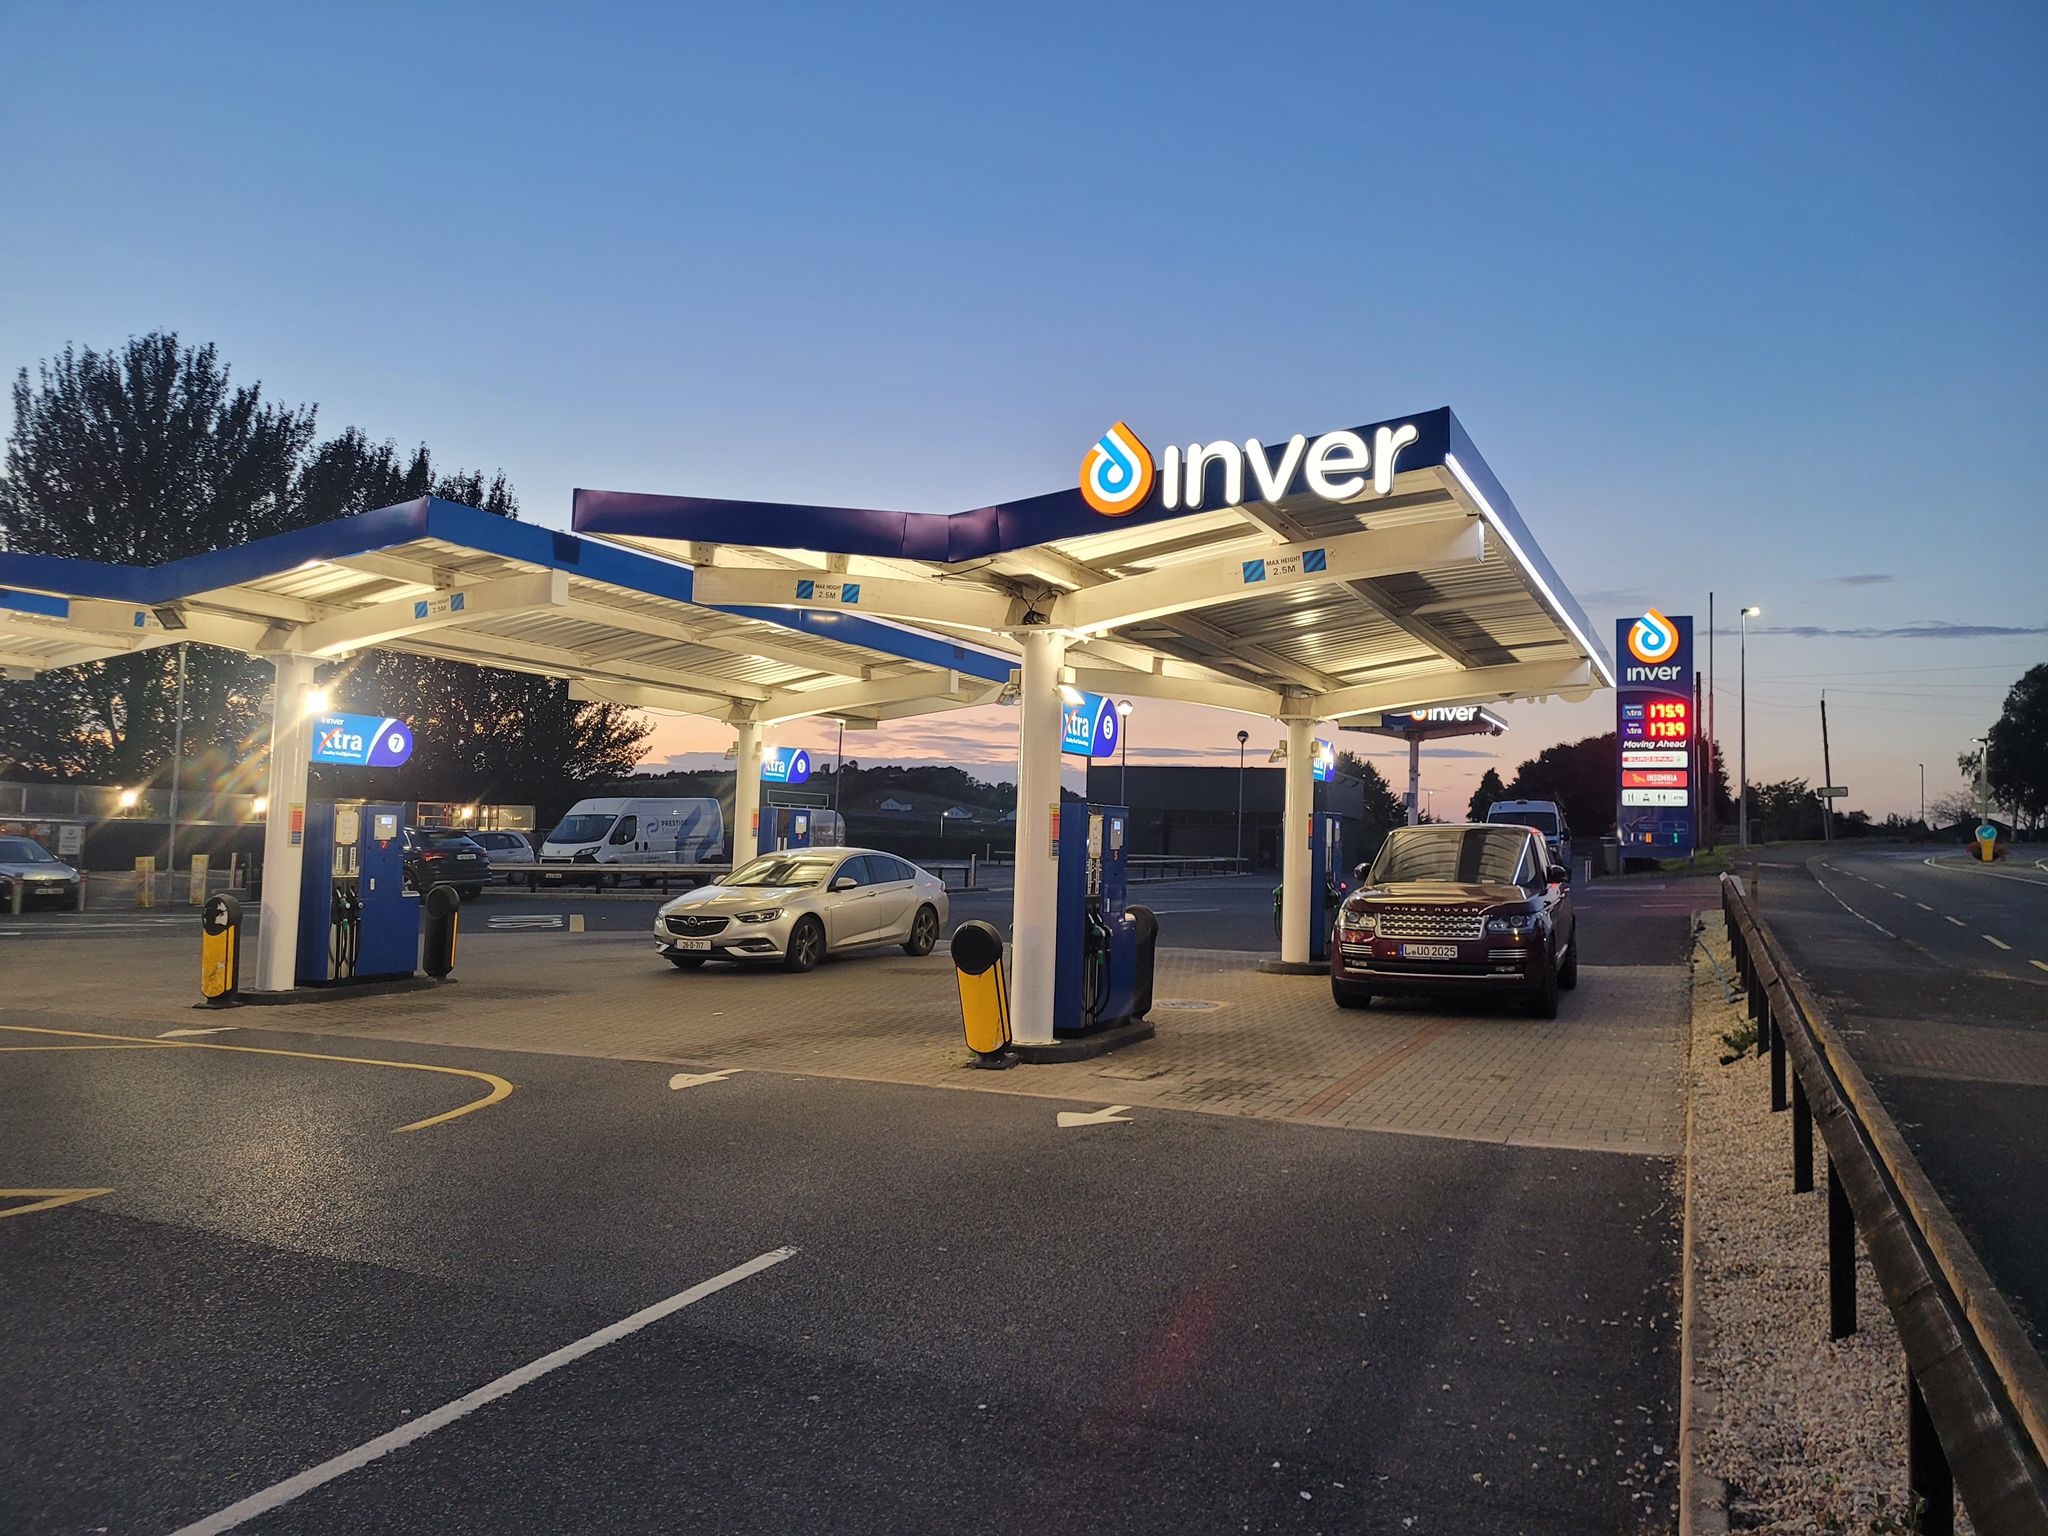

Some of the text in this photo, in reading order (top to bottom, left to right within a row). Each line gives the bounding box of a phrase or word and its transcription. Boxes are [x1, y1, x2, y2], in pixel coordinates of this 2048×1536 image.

[1163, 424, 1419, 510] inver
[1273, 565, 1295, 575] 2.5M
[818, 591, 836, 599] 2.5M
[1627, 666, 1681, 681] inver
[1428, 706, 1477, 721] inver
[1105, 719, 1111, 736] 5
[1623, 740, 1686, 749] Moving Ahead
[1431, 946, 1456, 957] 2025
